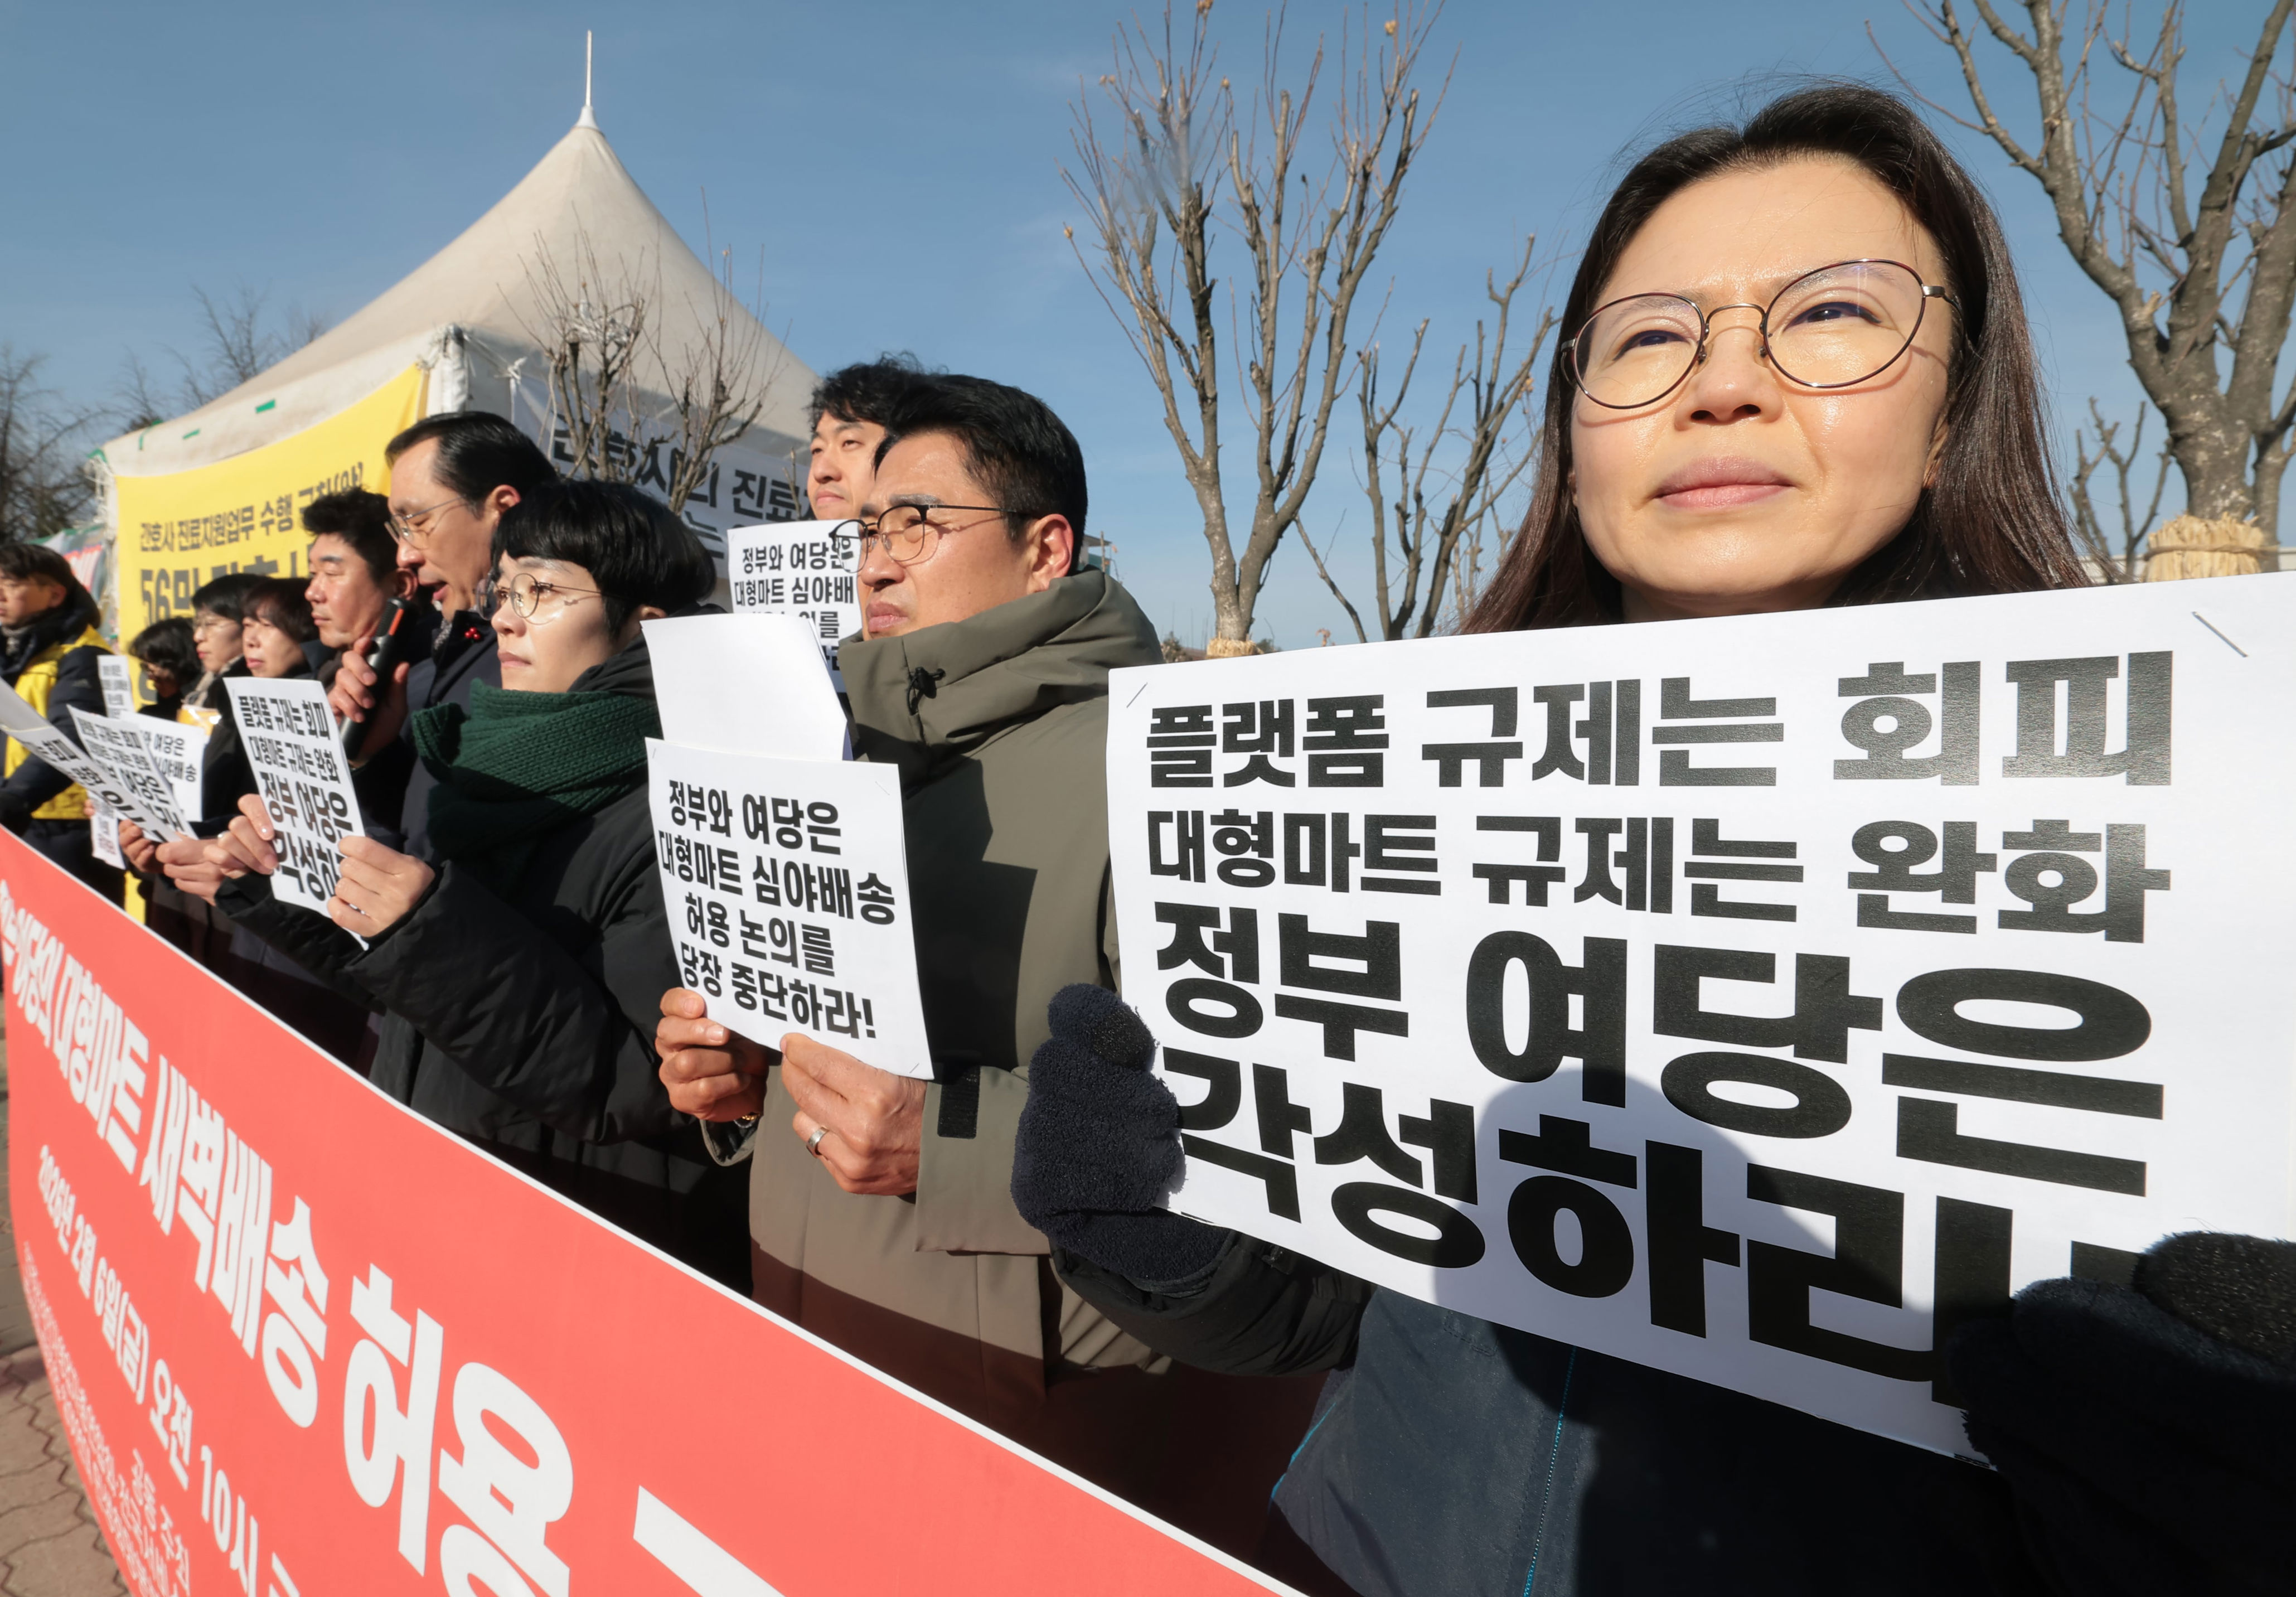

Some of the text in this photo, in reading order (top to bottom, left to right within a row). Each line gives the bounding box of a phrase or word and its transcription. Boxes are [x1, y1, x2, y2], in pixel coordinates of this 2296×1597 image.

[141, 522, 174, 552] 간호사
[260, 493, 293, 536] 수행
[732, 470, 816, 521] 진료
[734, 576, 854, 607] 대형마트 심야배
[743, 544, 783, 574] 정부와
[238, 696, 331, 741] 플랫폼 규제는 회피
[1146, 650, 2173, 788] 플랫폼 규제는 회피
[248, 736, 341, 784] 대형마트 규제는 완화
[260, 771, 353, 844] 정부 여당은
[669, 780, 841, 855] 정부와 여당은
[274, 829, 348, 902] 각성하
[658, 830, 895, 925] 대형마트 심야배송
[1147, 809, 2171, 944] 대형마트 규제는 완화
[685, 892, 835, 977] 허용 논의를
[681, 941, 876, 1039] 당장 중단하라!
[1154, 902, 2164, 1198] 정부 여당은
[1162, 1047, 2140, 1411] 각성하라
[53, 953, 149, 1175] 대형마트
[139, 1053, 330, 1428] 새벽배송
[343, 1262, 574, 1597] 허용
[94, 1256, 149, 1405] 6일(금)
[149, 1358, 193, 1490] 오전
[200, 1444, 259, 1597] 10시
